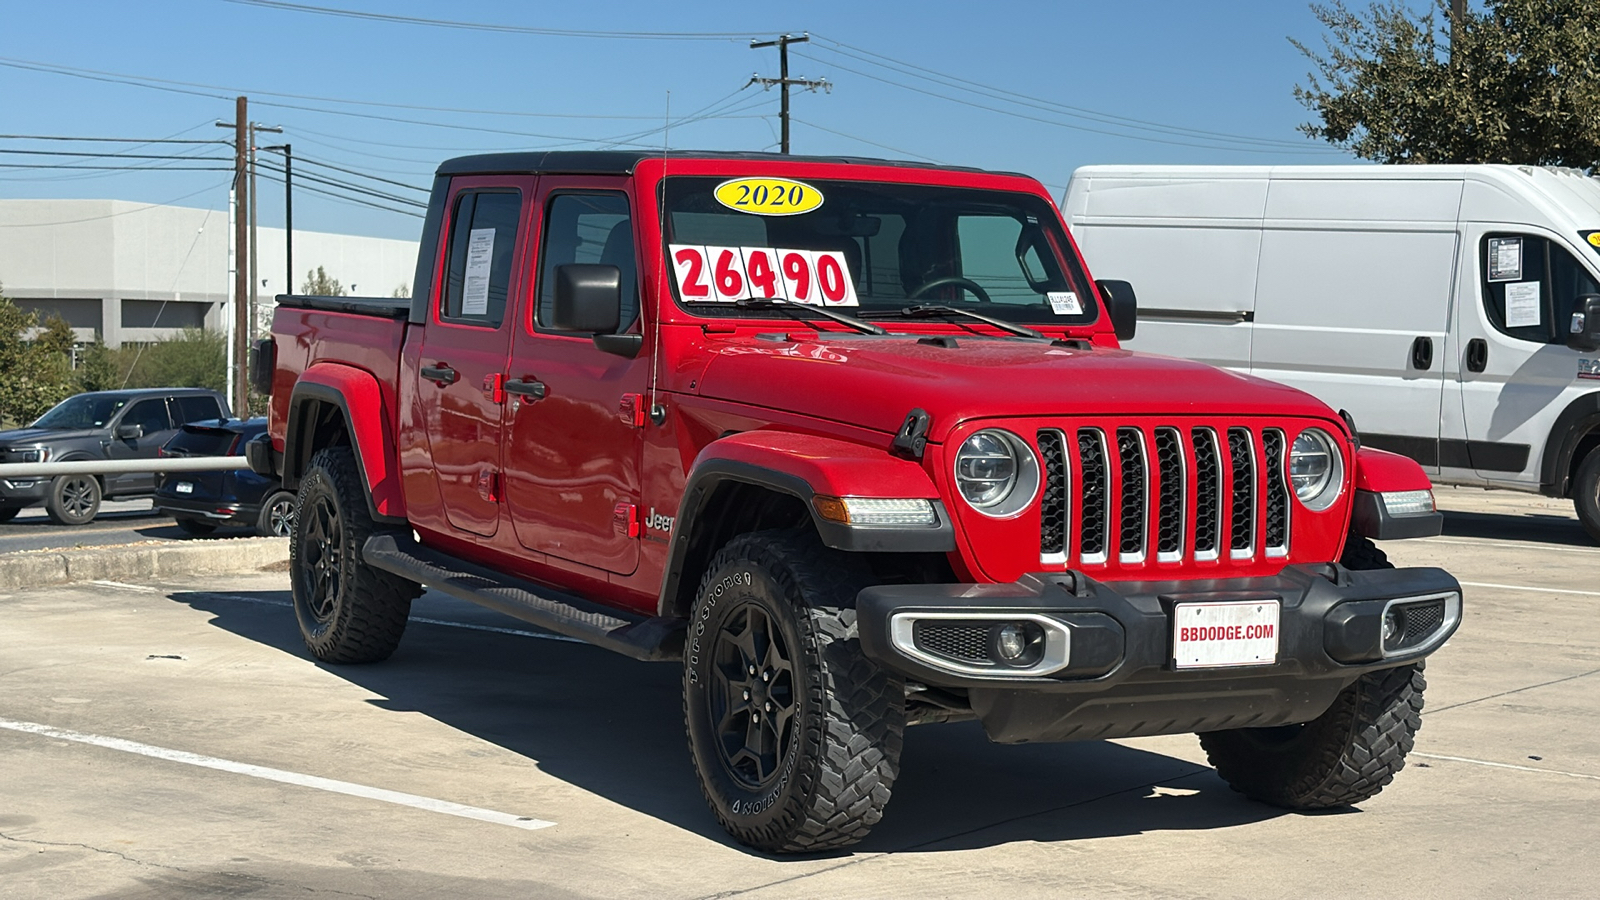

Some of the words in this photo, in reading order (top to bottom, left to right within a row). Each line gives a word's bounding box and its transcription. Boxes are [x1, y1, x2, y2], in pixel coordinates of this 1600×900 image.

[735, 184, 805, 207] 2020
[675, 248, 848, 303] 26490
[688, 572, 743, 684] Firestone
[1180, 624, 1274, 642] BBDODGE.COM
[742, 702, 802, 815] DESTINATION
